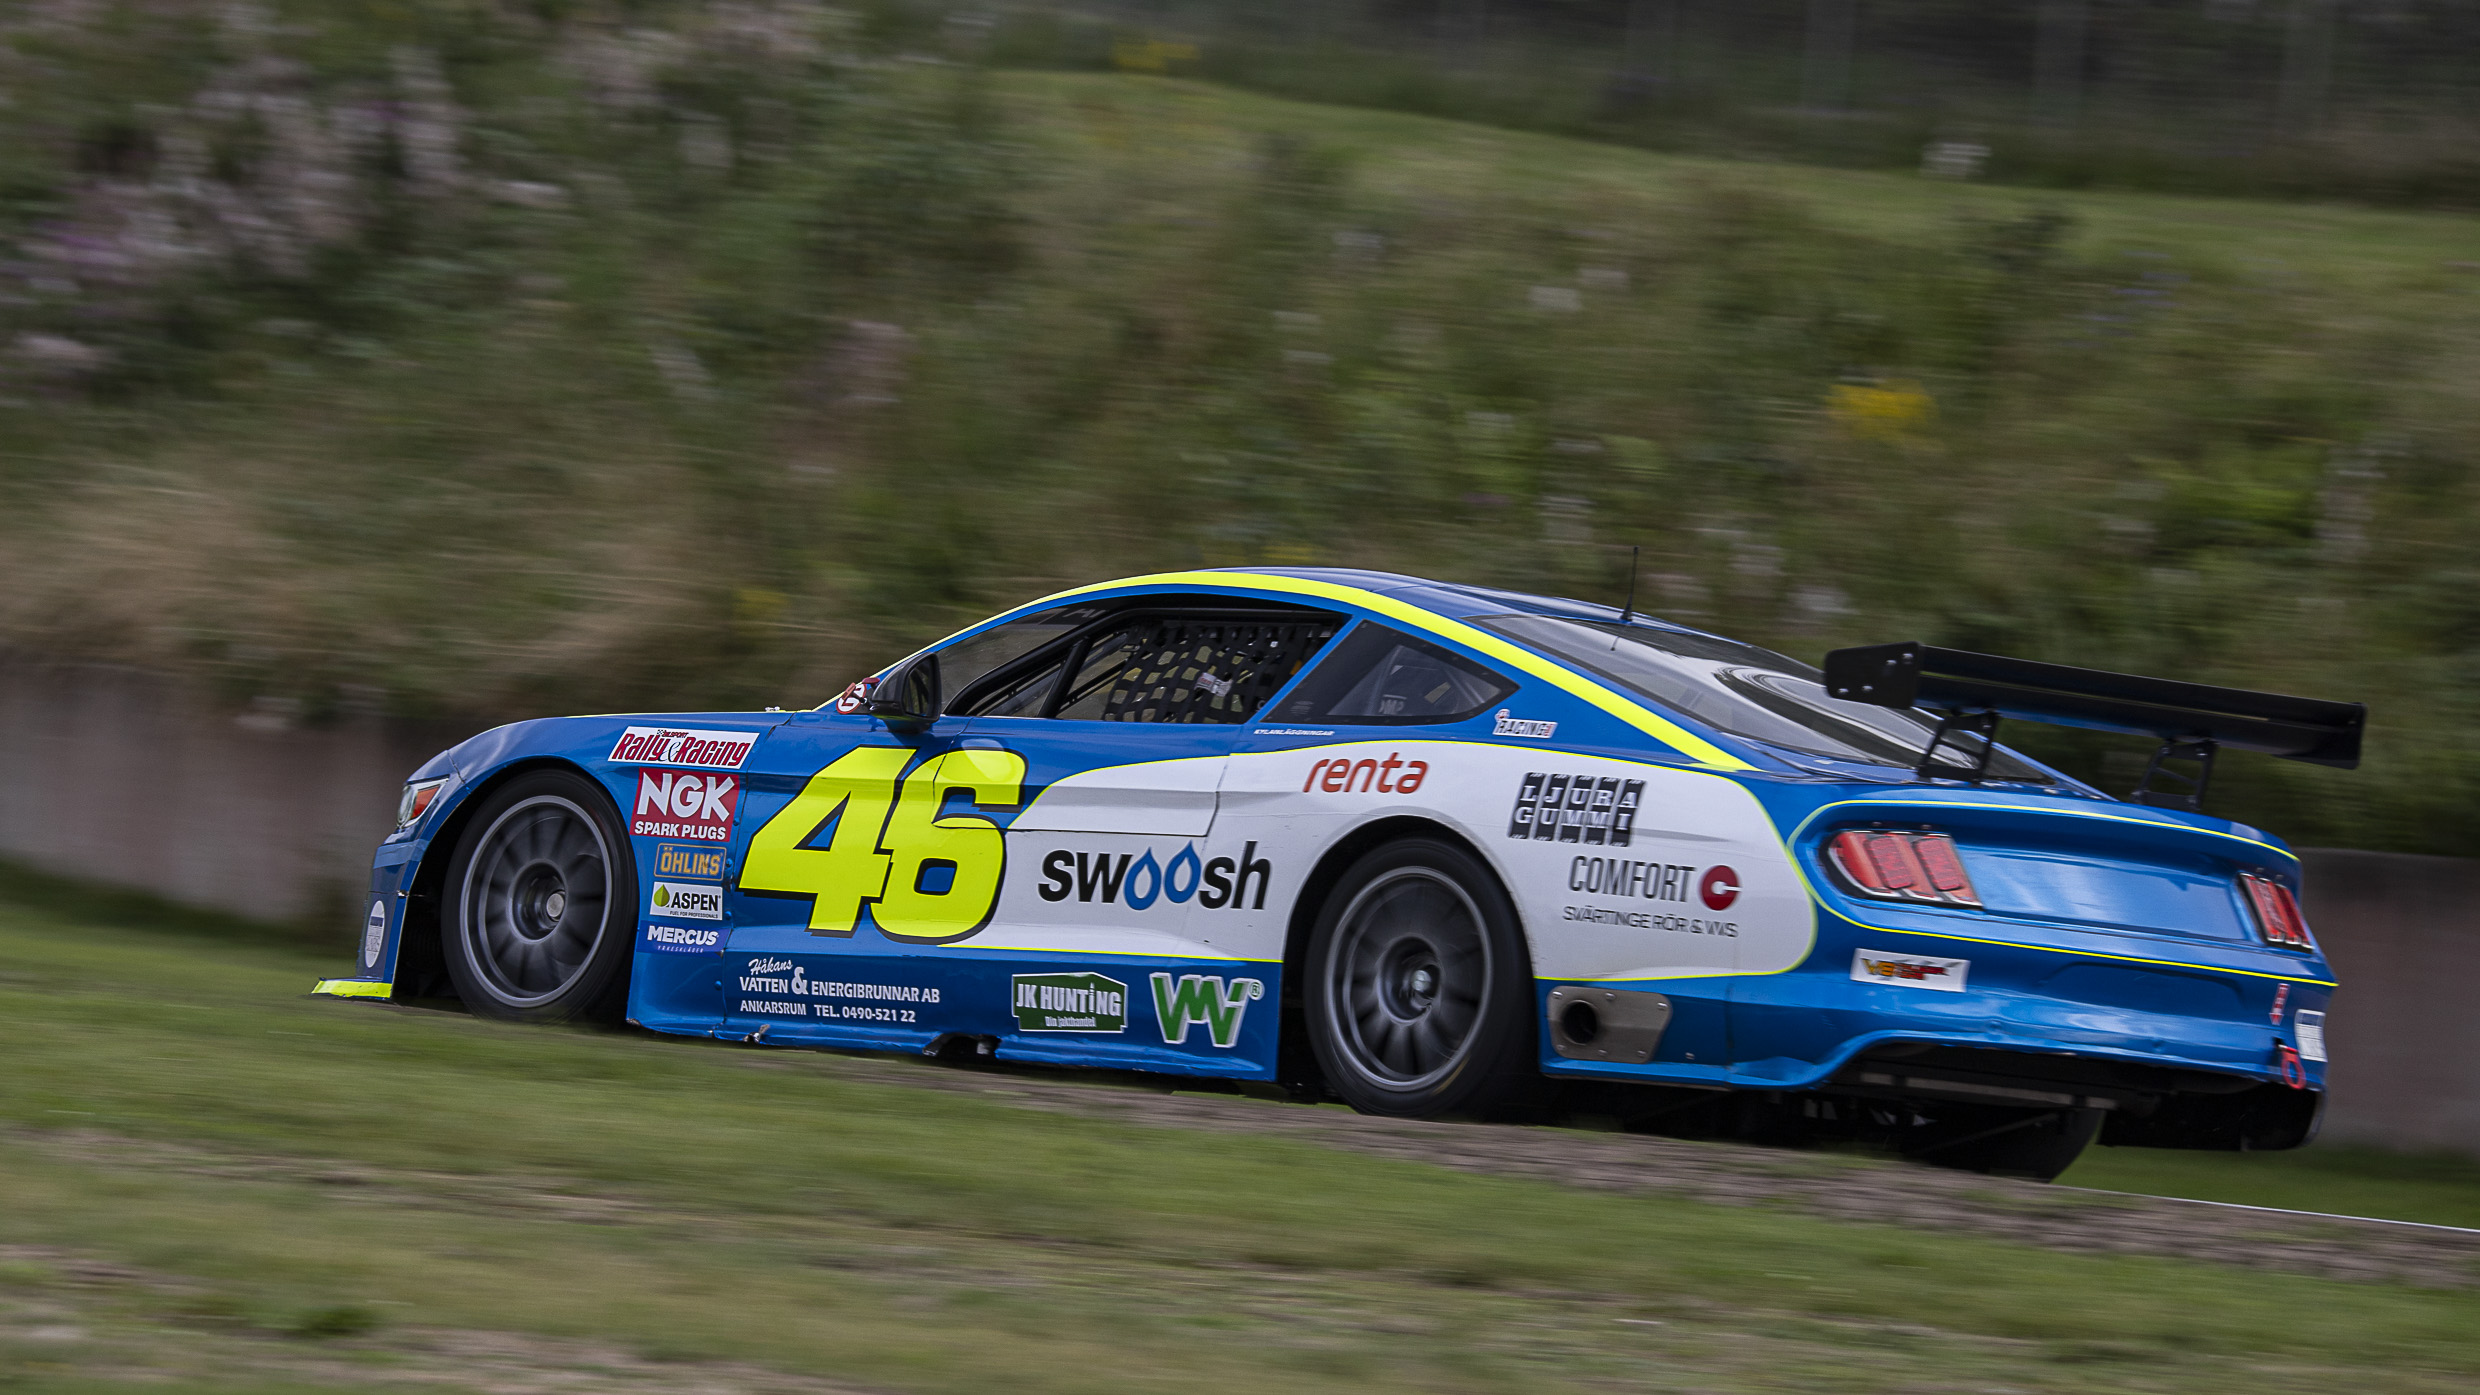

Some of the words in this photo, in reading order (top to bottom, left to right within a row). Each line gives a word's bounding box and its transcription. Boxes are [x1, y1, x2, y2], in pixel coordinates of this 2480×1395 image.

[612, 733, 671, 761] Rally
[675, 736, 751, 767] Racing
[1302, 752, 1429, 794] renta
[636, 772, 735, 822] NGK
[1519, 785, 1638, 809] LJURA
[634, 820, 679, 837] SPARK
[681, 824, 726, 840] PLUGS
[1514, 806, 1631, 831] GUMMI
[735, 744, 1029, 944] 46
[660, 846, 720, 876] ÖHLINS
[1037, 840, 1271, 911] swoosh
[1569, 855, 1697, 903] COMFORT
[671, 891, 718, 912] ASPEN
[1562, 904, 1651, 929] SVÄRTINGE
[1651, 913, 1689, 932] RÖR
[1689, 919, 1706, 934] &
[647, 925, 719, 946] MERCUS
[748, 957, 793, 975] Håkans
[739, 976, 789, 994] VATTEN
[791, 966, 809, 995] &
[811, 980, 920, 1002] ENERGIBRUNNAR
[921, 988, 941, 1003] AB
[1016, 983, 1038, 1008] JK
[739, 1000, 807, 1016] ANKARSRUM
[813, 1004, 840, 1018] TEL.
[841, 1006, 898, 1021] 0490-521
[899, 1010, 917, 1023] 22
